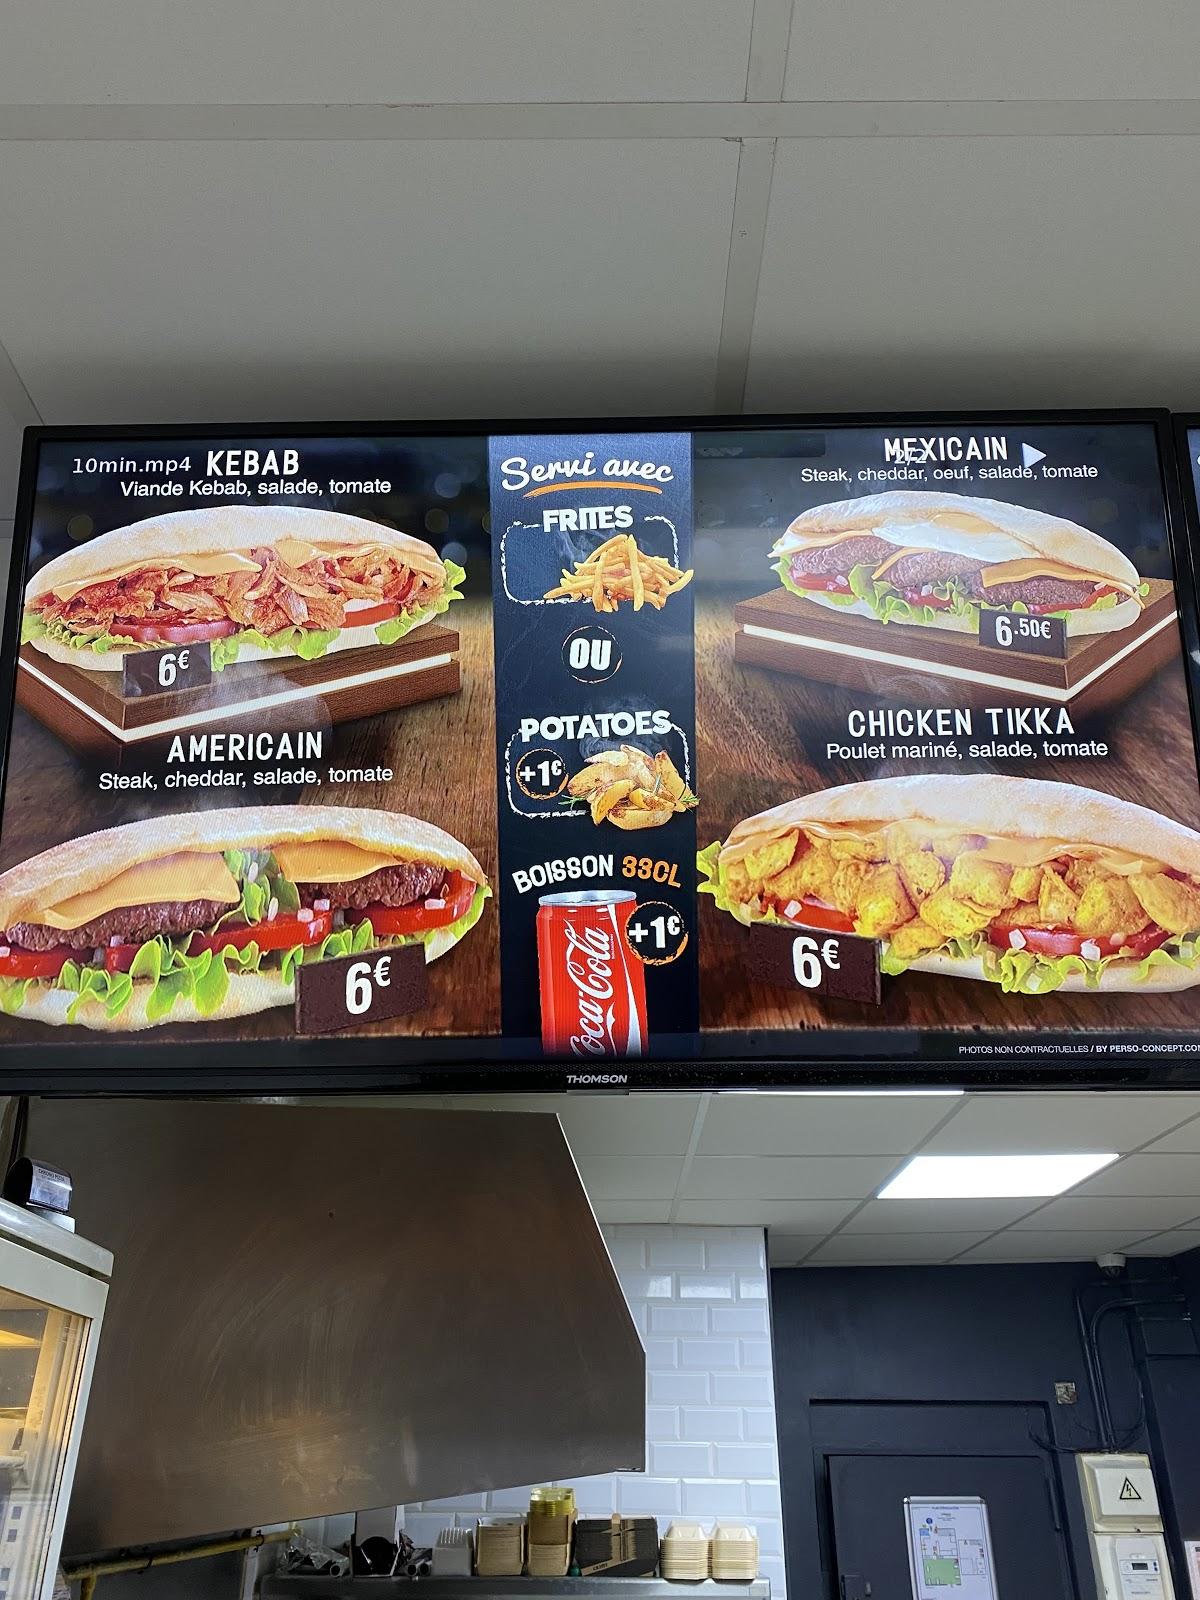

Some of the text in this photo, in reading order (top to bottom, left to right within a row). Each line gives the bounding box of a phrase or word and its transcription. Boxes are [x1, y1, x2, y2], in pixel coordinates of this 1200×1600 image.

[206, 449, 300, 477] KEBAB
[884, 436, 1008, 462] MEXICAIN
[72, 456, 192, 475] 10min.mp4
[501, 452, 674, 491] Servi avec
[801, 464, 1098, 483] Steak, cheddar, oeuf, salade, tomate
[120, 478, 392, 497] Viande Kebab, salade, tomate
[543, 505, 633, 532] FRITES
[569, 637, 611, 671] OU
[158, 650, 190, 687] 6€
[520, 710, 672, 742] POTATOES
[848, 707, 1075, 737] CHICKEN TIKKA
[166, 731, 323, 763] AMERICAIN
[827, 741, 1108, 759] Poulet mariné, salade, tomate
[99, 766, 393, 791] Steak, cheddar, salade, tomate
[519, 759, 563, 786] +1€
[512, 854, 681, 893] BOISSON 33CL
[629, 915, 680, 949] +1€
[792, 937, 840, 989] 6€
[345, 956, 392, 1016] 6€
[958, 1046, 993, 1054] PHOTOS
[995, 1045, 1013, 1053] NON
[1015, 1045, 1089, 1053] CONTRACTUELLES
[1096, 1044, 1108, 1053] BY
[566, 1074, 628, 1084] THOMSON
